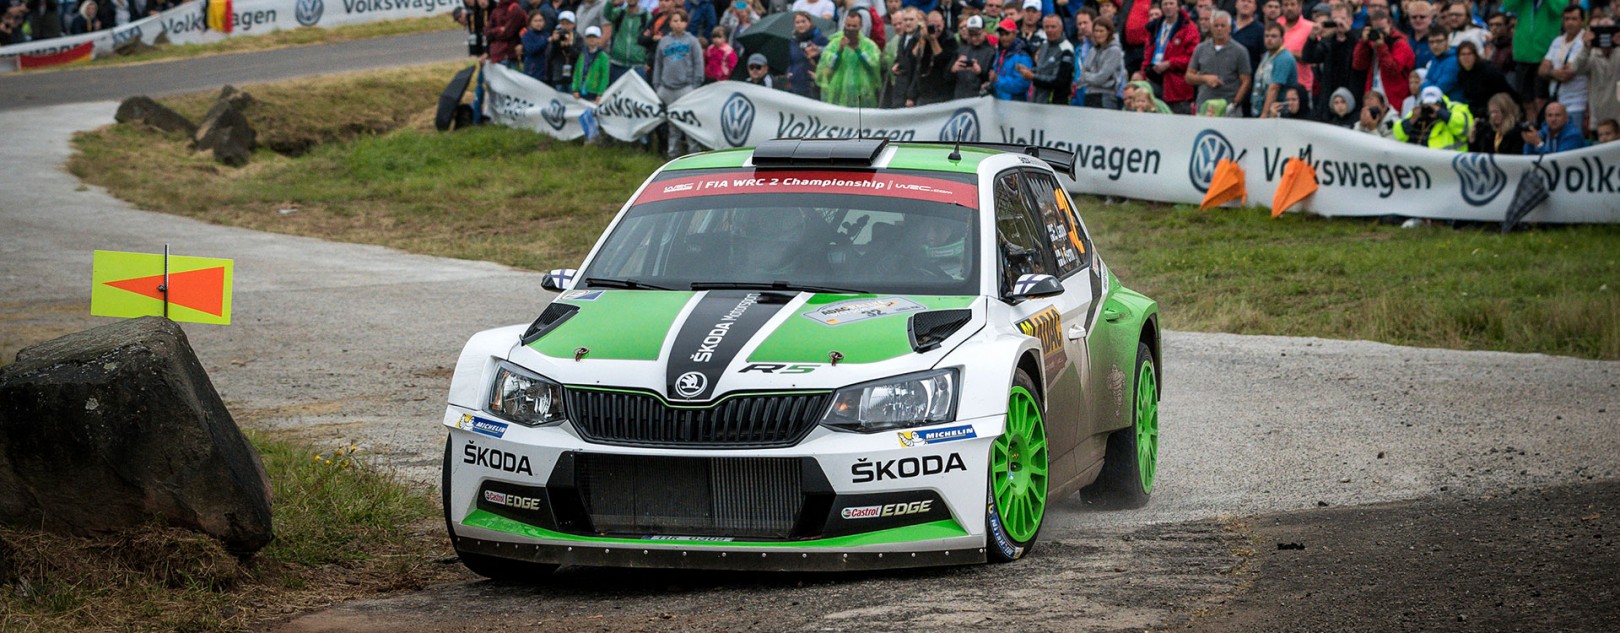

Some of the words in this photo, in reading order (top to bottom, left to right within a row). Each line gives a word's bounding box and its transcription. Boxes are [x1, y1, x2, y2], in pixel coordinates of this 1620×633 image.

[160, 9, 278, 34] Volkagen
[705, 179, 729, 190] FIA
[733, 177, 766, 188] WRC
[768, 177, 779, 187] 2
[782, 177, 886, 191] Championship
[689, 321, 735, 363] ŠKODA
[737, 363, 822, 375] R5
[475, 421, 506, 433] MICHELIN
[925, 427, 974, 440] MICHELIN
[463, 440, 534, 477] ŠKODA
[851, 452, 968, 484] ŠKODA
[506, 494, 542, 511] EDGE
[851, 506, 880, 518] Castrol
[880, 499, 935, 518] EDGE
